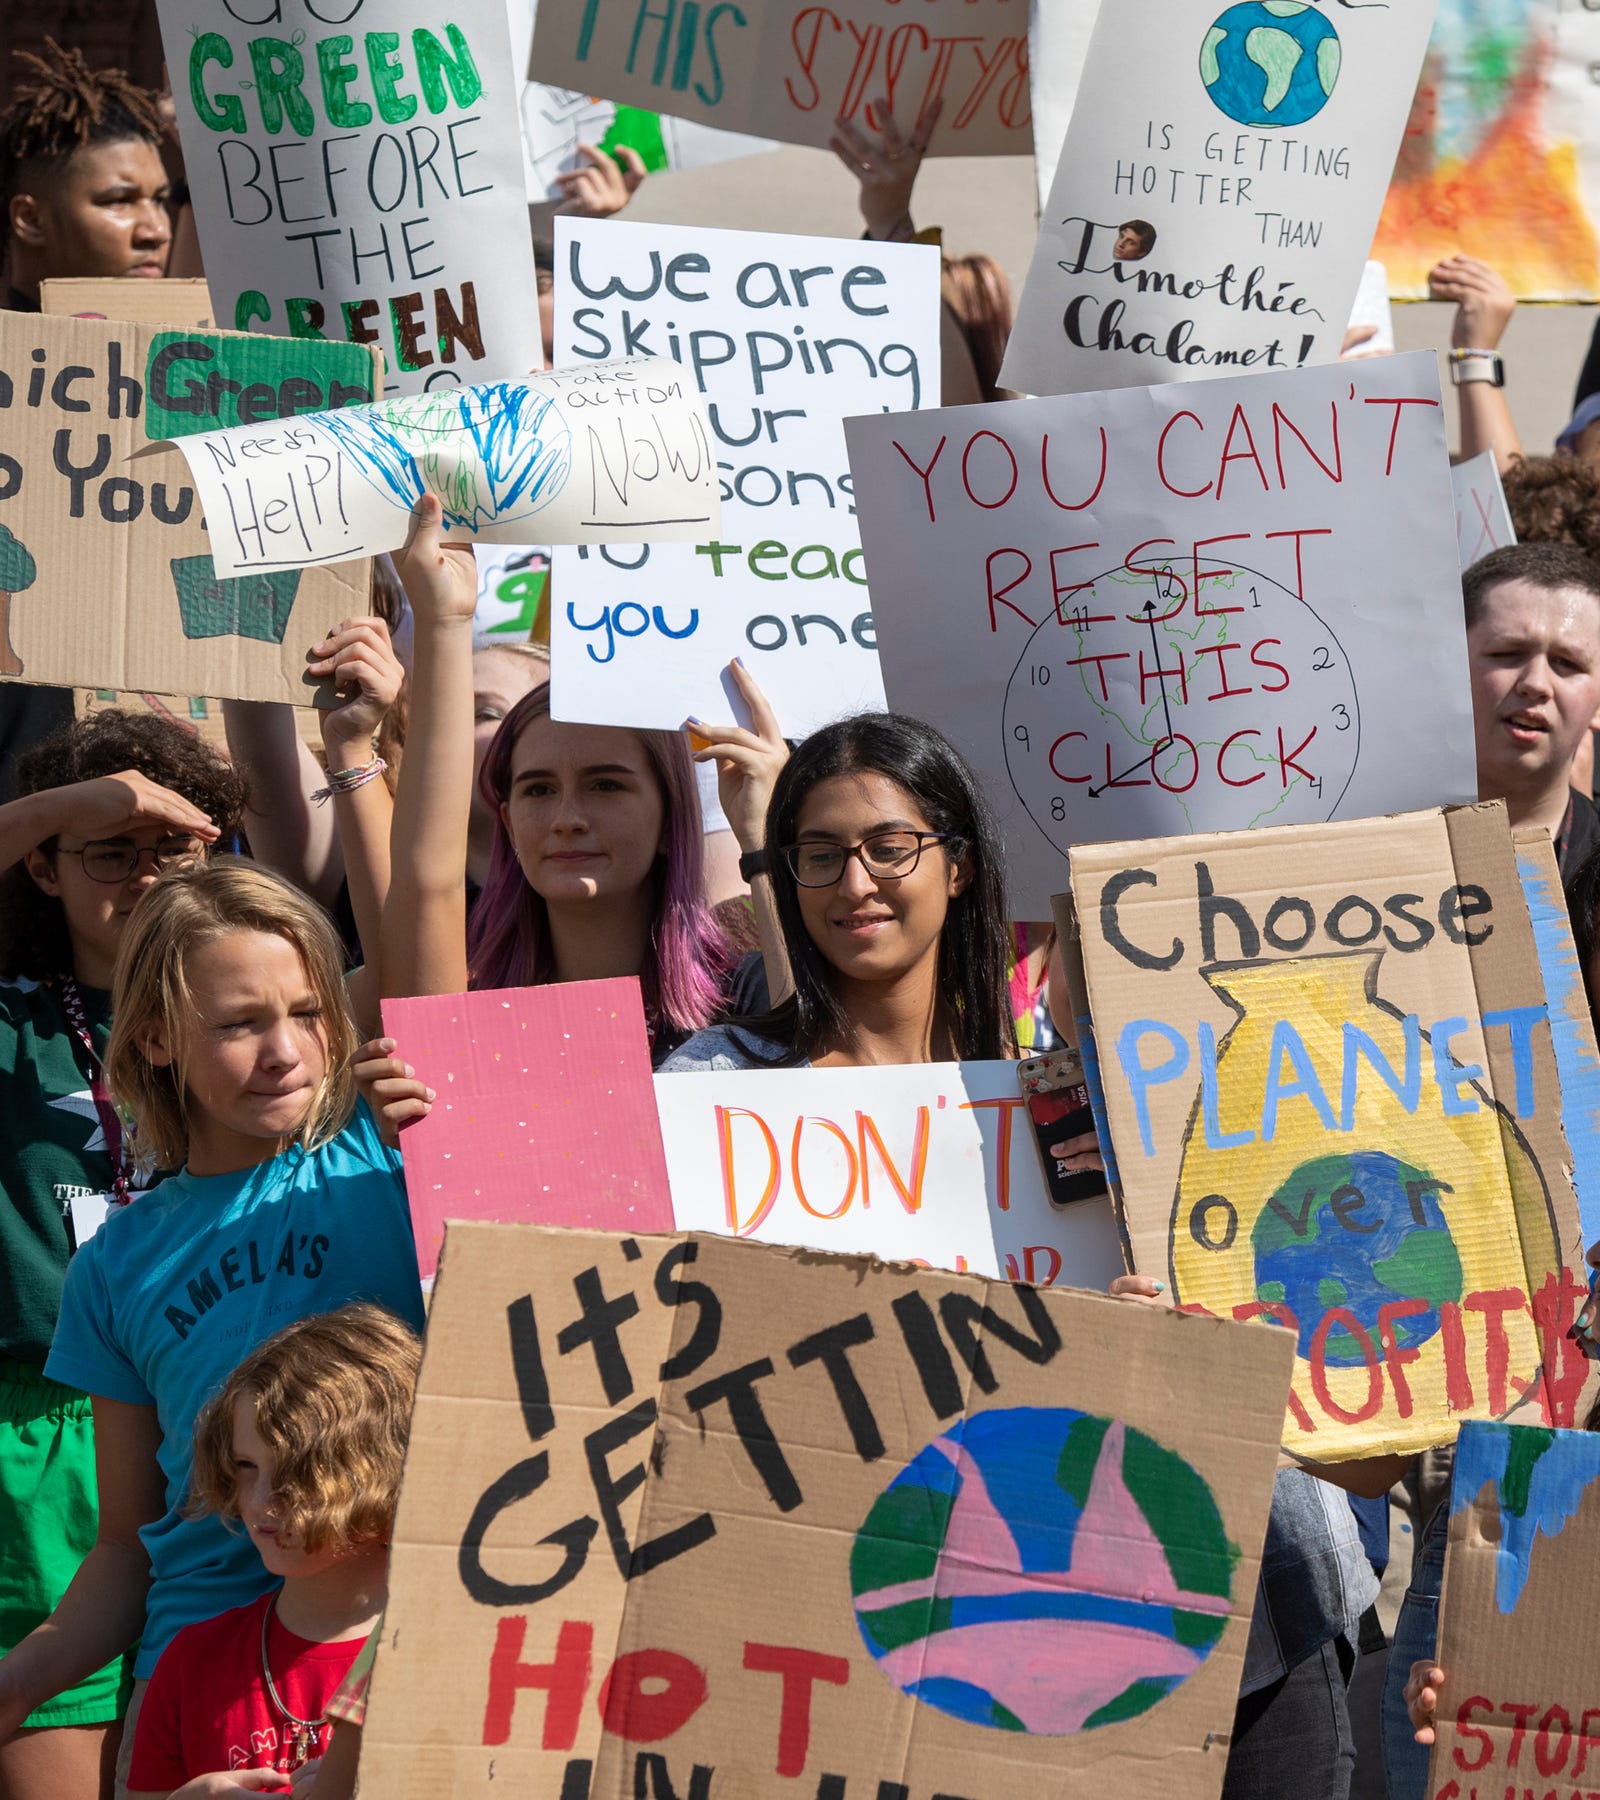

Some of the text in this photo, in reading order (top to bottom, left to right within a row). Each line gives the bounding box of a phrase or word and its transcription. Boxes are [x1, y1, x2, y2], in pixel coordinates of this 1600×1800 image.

[187, 22, 487, 136] GREEN
[217, 116, 494, 226] BEFORE
[1146, 120, 1350, 180] IS GETTING
[1114, 160, 1253, 206] HOTTER
[285, 217, 445, 290] THE
[1254, 212, 1324, 249] THAN
[736, 261, 890, 317] are
[1063, 294, 1316, 368] Chalamet!
[150, 340, 372, 426] Green
[543, 371, 640, 389] Take
[567, 381, 683, 408] action
[204, 427, 317, 476] Needs
[708, 402, 808, 447] ur
[892, 383, 1440, 523] YOU CAN'T
[695, 539, 868, 587] teac
[984, 528, 1333, 633] RESET
[1152, 565, 1182, 600] 12
[1249, 586, 1262, 608] 1
[566, 600, 700, 664] you
[1312, 646, 1336, 672] 2
[1031, 664, 1051, 687] 10
[1065, 638, 1291, 706] THIS
[1013, 725, 1031, 753] 9
[1331, 703, 1352, 731] 3
[1049, 724, 1320, 794] CLOCK
[1309, 775, 1323, 800] 4
[1050, 796, 1067, 823] 8
[1099, 861, 1495, 972] Choose
[1077, 1084, 1089, 1107] VISA
[1114, 1001, 1550, 1157] PLANET
[713, 1094, 1026, 1238] DON'T
[1188, 1176, 1456, 1253] over
[458, 1282, 1064, 1608] GETTIN
[481, 1614, 850, 1779] HOT
